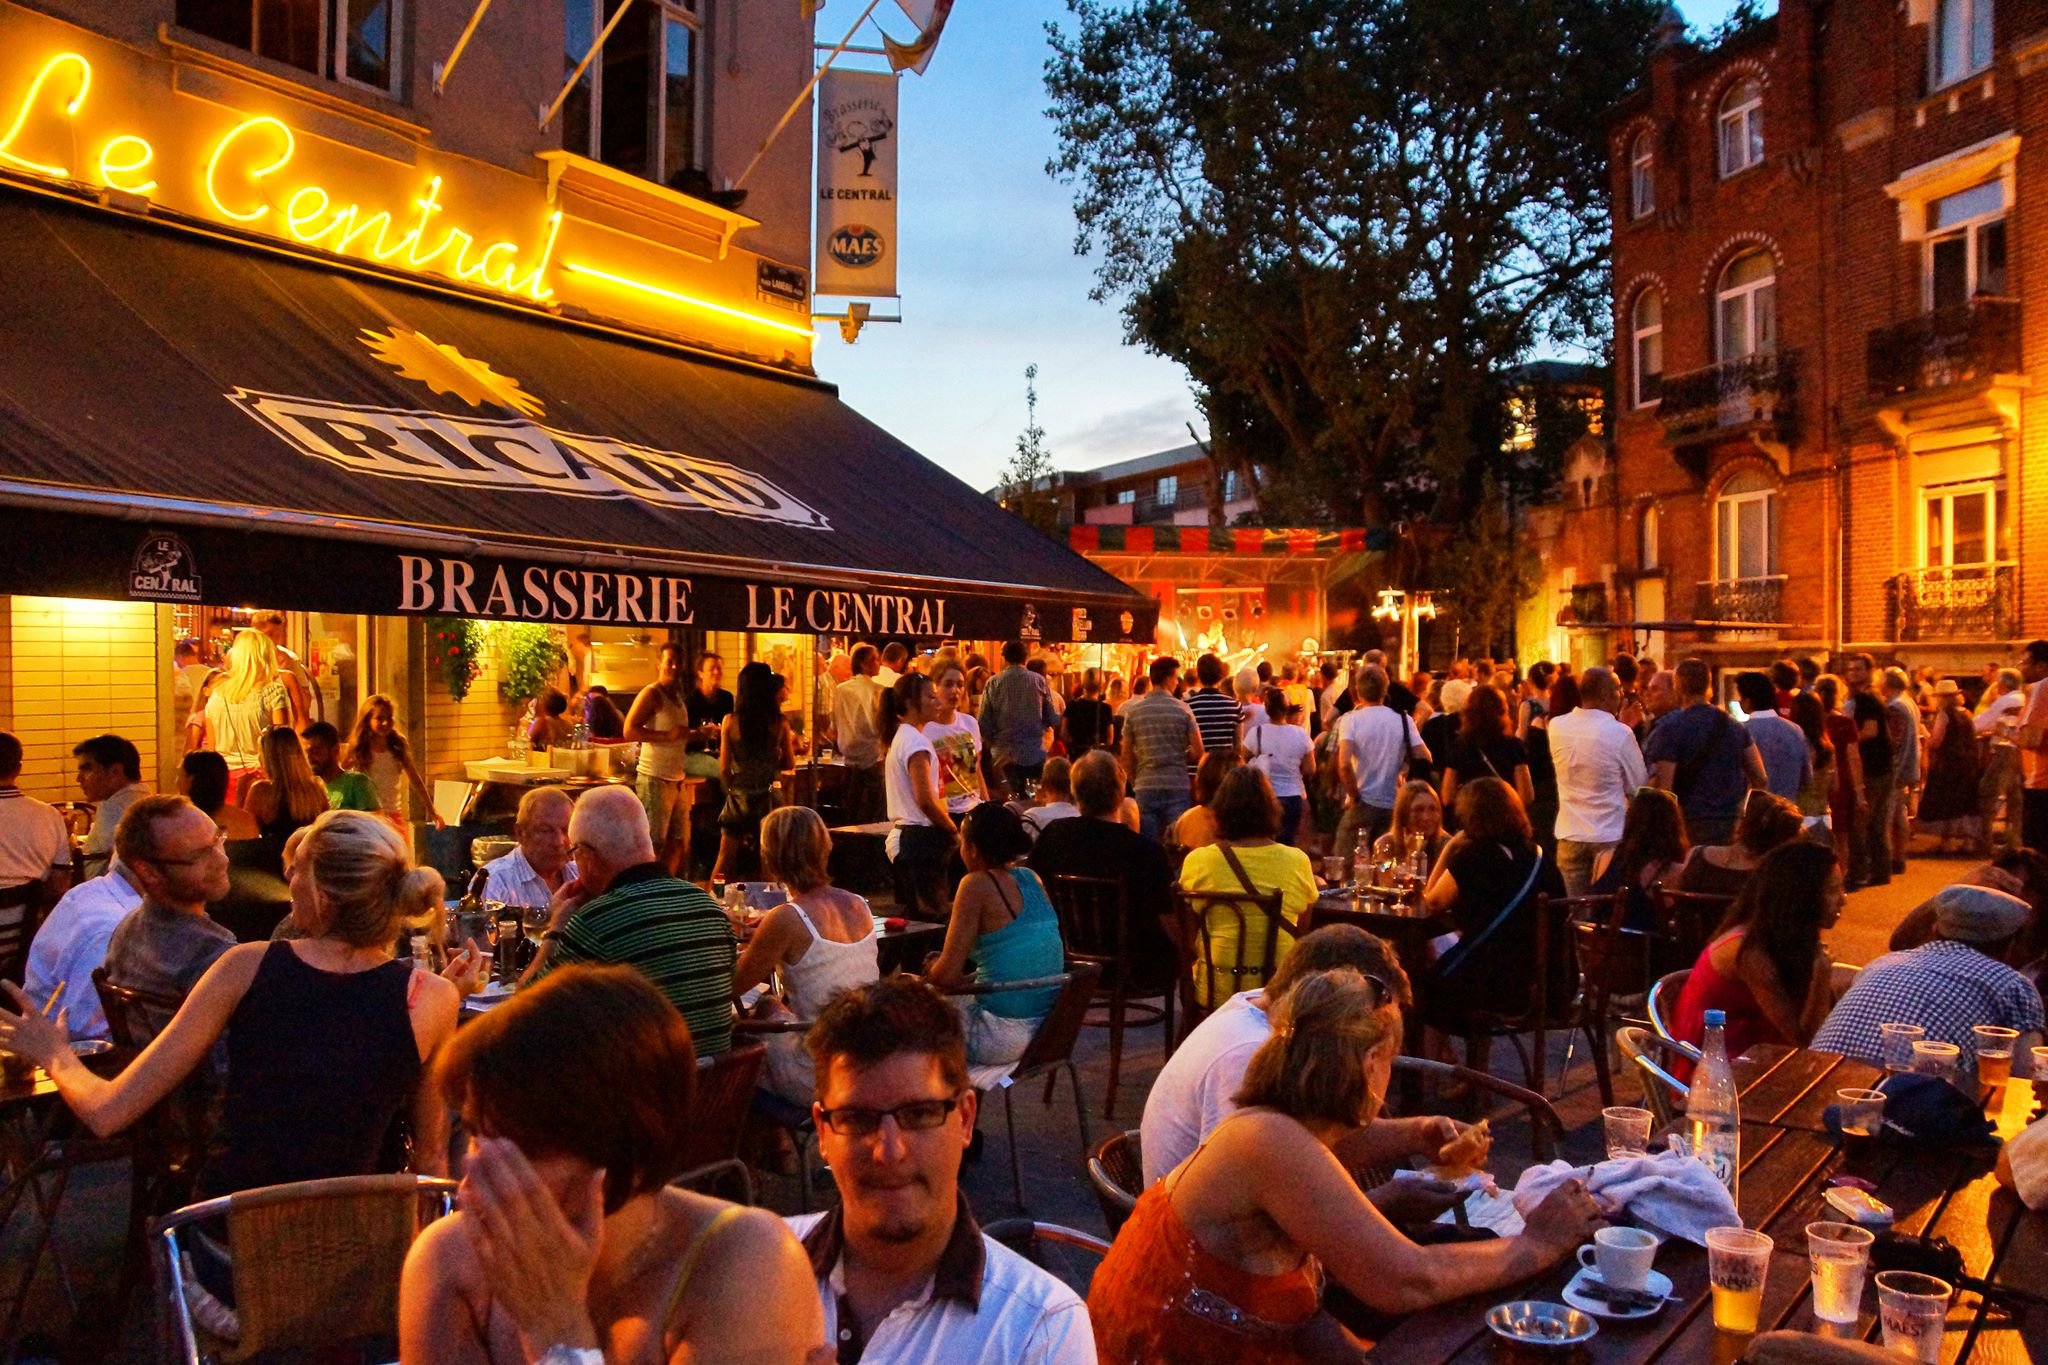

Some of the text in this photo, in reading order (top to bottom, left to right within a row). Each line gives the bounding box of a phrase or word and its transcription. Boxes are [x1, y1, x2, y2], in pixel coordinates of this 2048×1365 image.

[0, 52, 562, 300] Le Central
[820, 188, 892, 201] LE CENTRAL
[830, 237, 884, 257] MAES
[277, 411, 782, 510] RICARD
[157, 540, 169, 551] LE
[397, 554, 695, 625] BRASSERIE
[745, 584, 955, 637] LE CENTRAL
